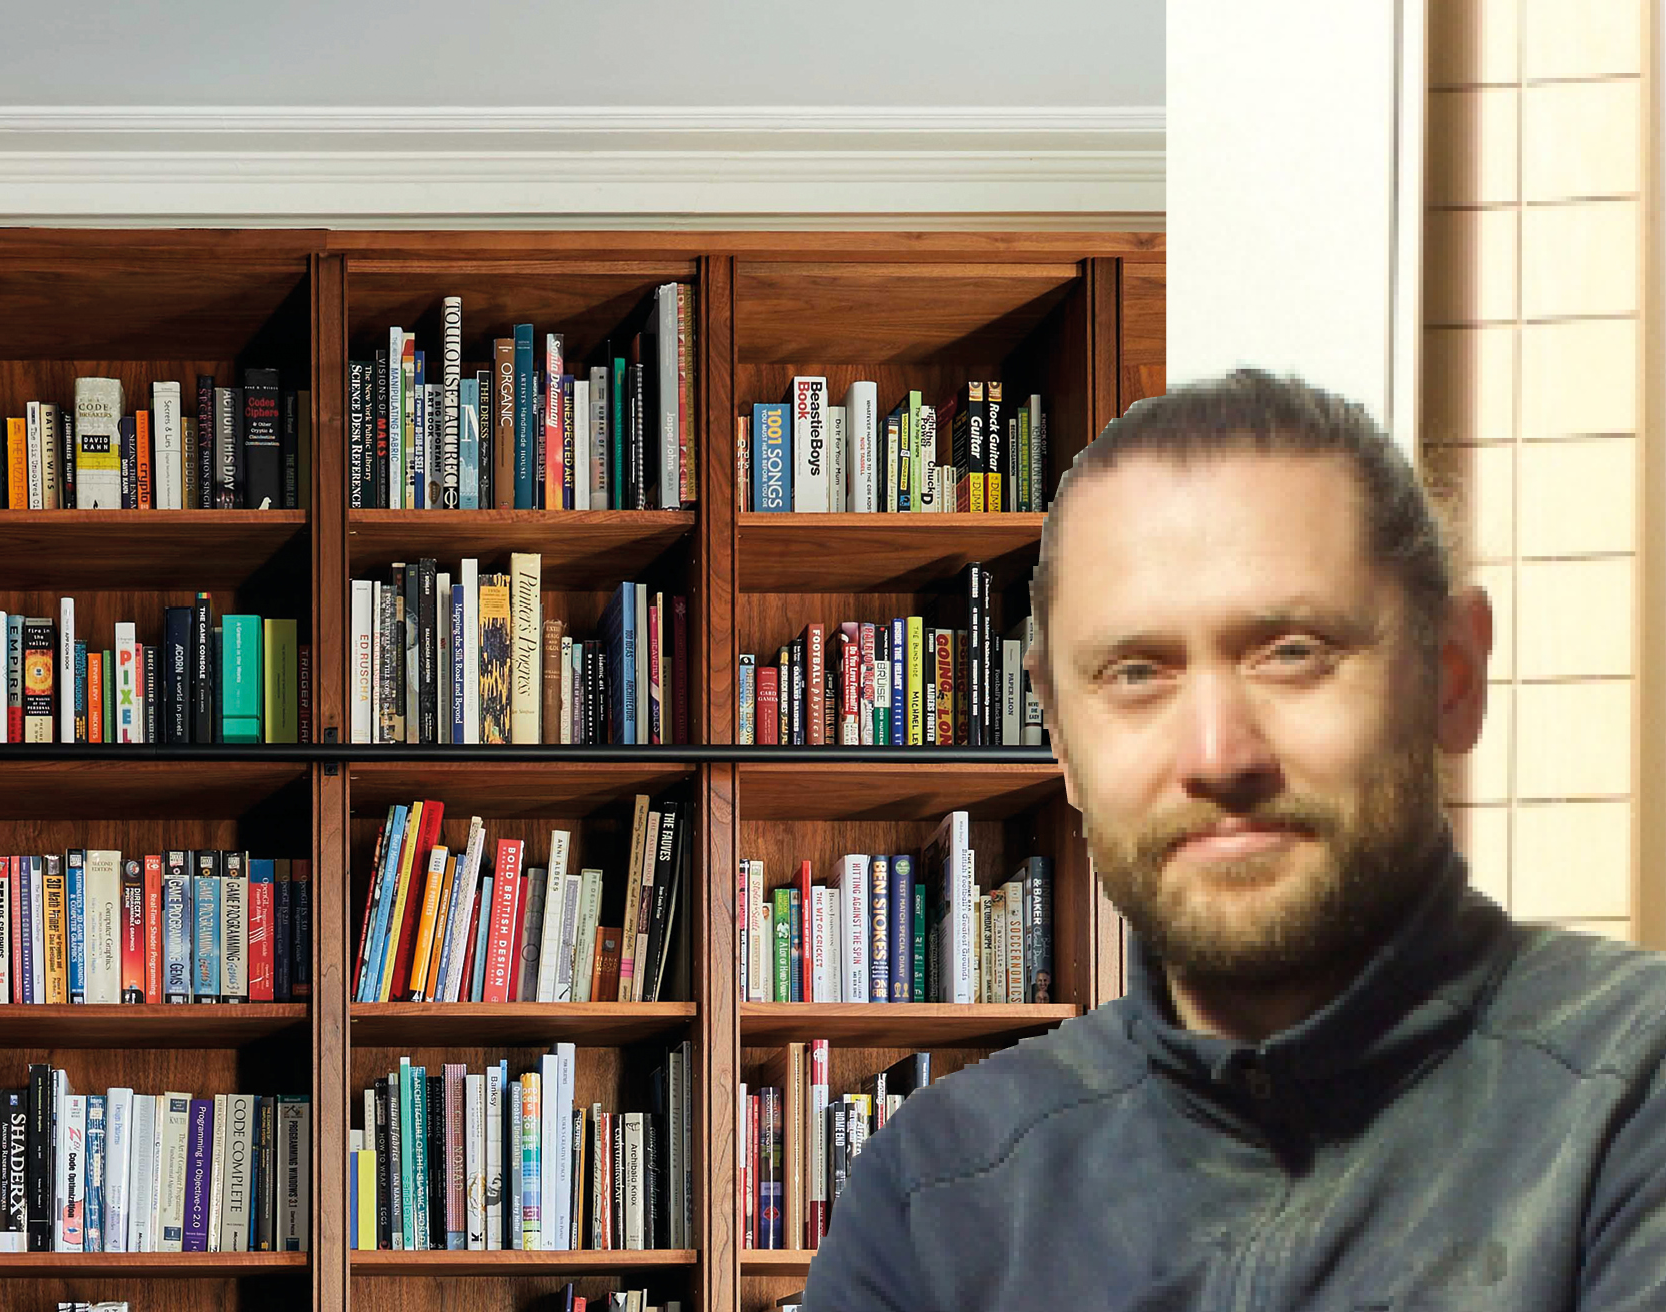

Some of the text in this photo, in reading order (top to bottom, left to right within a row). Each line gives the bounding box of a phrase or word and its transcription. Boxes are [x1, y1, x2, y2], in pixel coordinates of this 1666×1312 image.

[245, 409, 279, 417] Ciphers
[249, 398, 274, 406] Codes
[500, 362, 513, 427] ORGANIC
[549, 340, 560, 428] Sonia Delaunay
[798, 381, 809, 420] Book
[352, 366, 362, 508] SCIENCE DESK REFERENCE
[564, 396, 572, 465] UNEXPECTED
[768, 409, 782, 509] 1001 SONGS
[971, 416, 983, 458] Guitar
[990, 403, 999, 471] Rock Guitar
[138, 463, 147, 502] crypto
[9, 626, 18, 702] EMPIRE
[360, 634, 368, 702] ED RUSCHA
[516, 571, 538, 697] Painter's Progress
[937, 634, 953, 692] GOING
[811, 688, 819, 738] physics
[660, 812, 675, 861] THE FAUVES
[169, 880, 184, 986] GAME PROGRAMMING GEMS
[495, 847, 516, 985] BOLD BRITISH DESIGN
[853, 863, 861, 964] HITTING AGAINST THE SPIN
[872, 861, 887, 960] BEN STOKES
[149, 952, 157, 995] Programming
[1012, 920, 1021, 1002] SOCCERNOMICS
[195, 1106, 206, 1157] Programming
[231, 1099, 246, 1212] CODE COMPLETE
[194, 1169, 203, 1211] Objective-C
